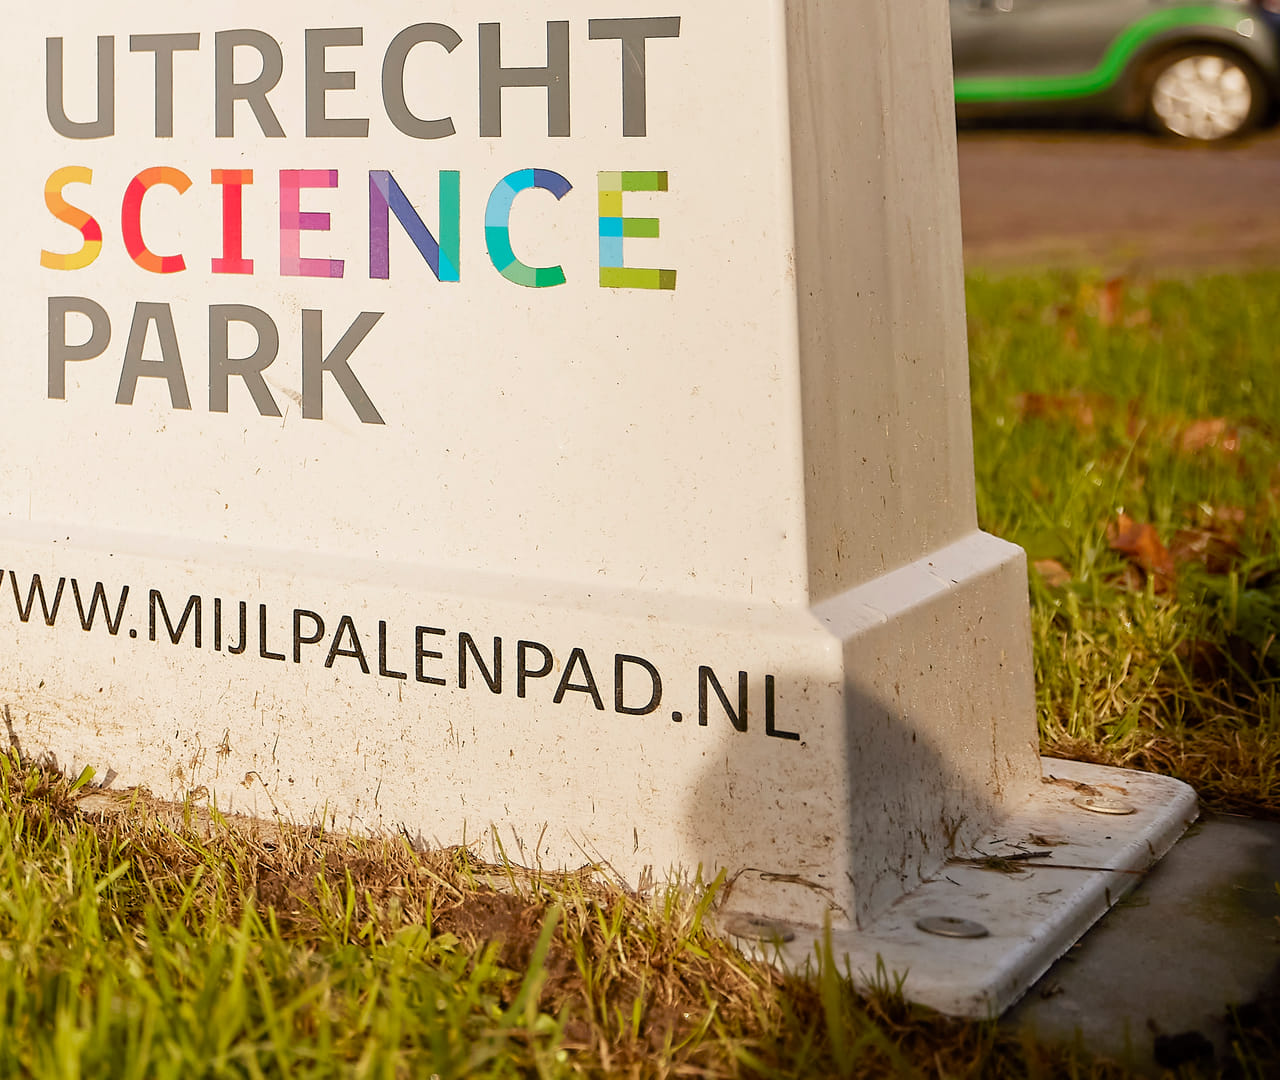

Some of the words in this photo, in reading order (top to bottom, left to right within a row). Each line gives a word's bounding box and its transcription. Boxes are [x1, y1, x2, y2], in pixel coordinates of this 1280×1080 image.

[45, 15, 682, 140] UTRECHT
[39, 165, 678, 291] SCIENCE
[46, 295, 386, 426] PARK
